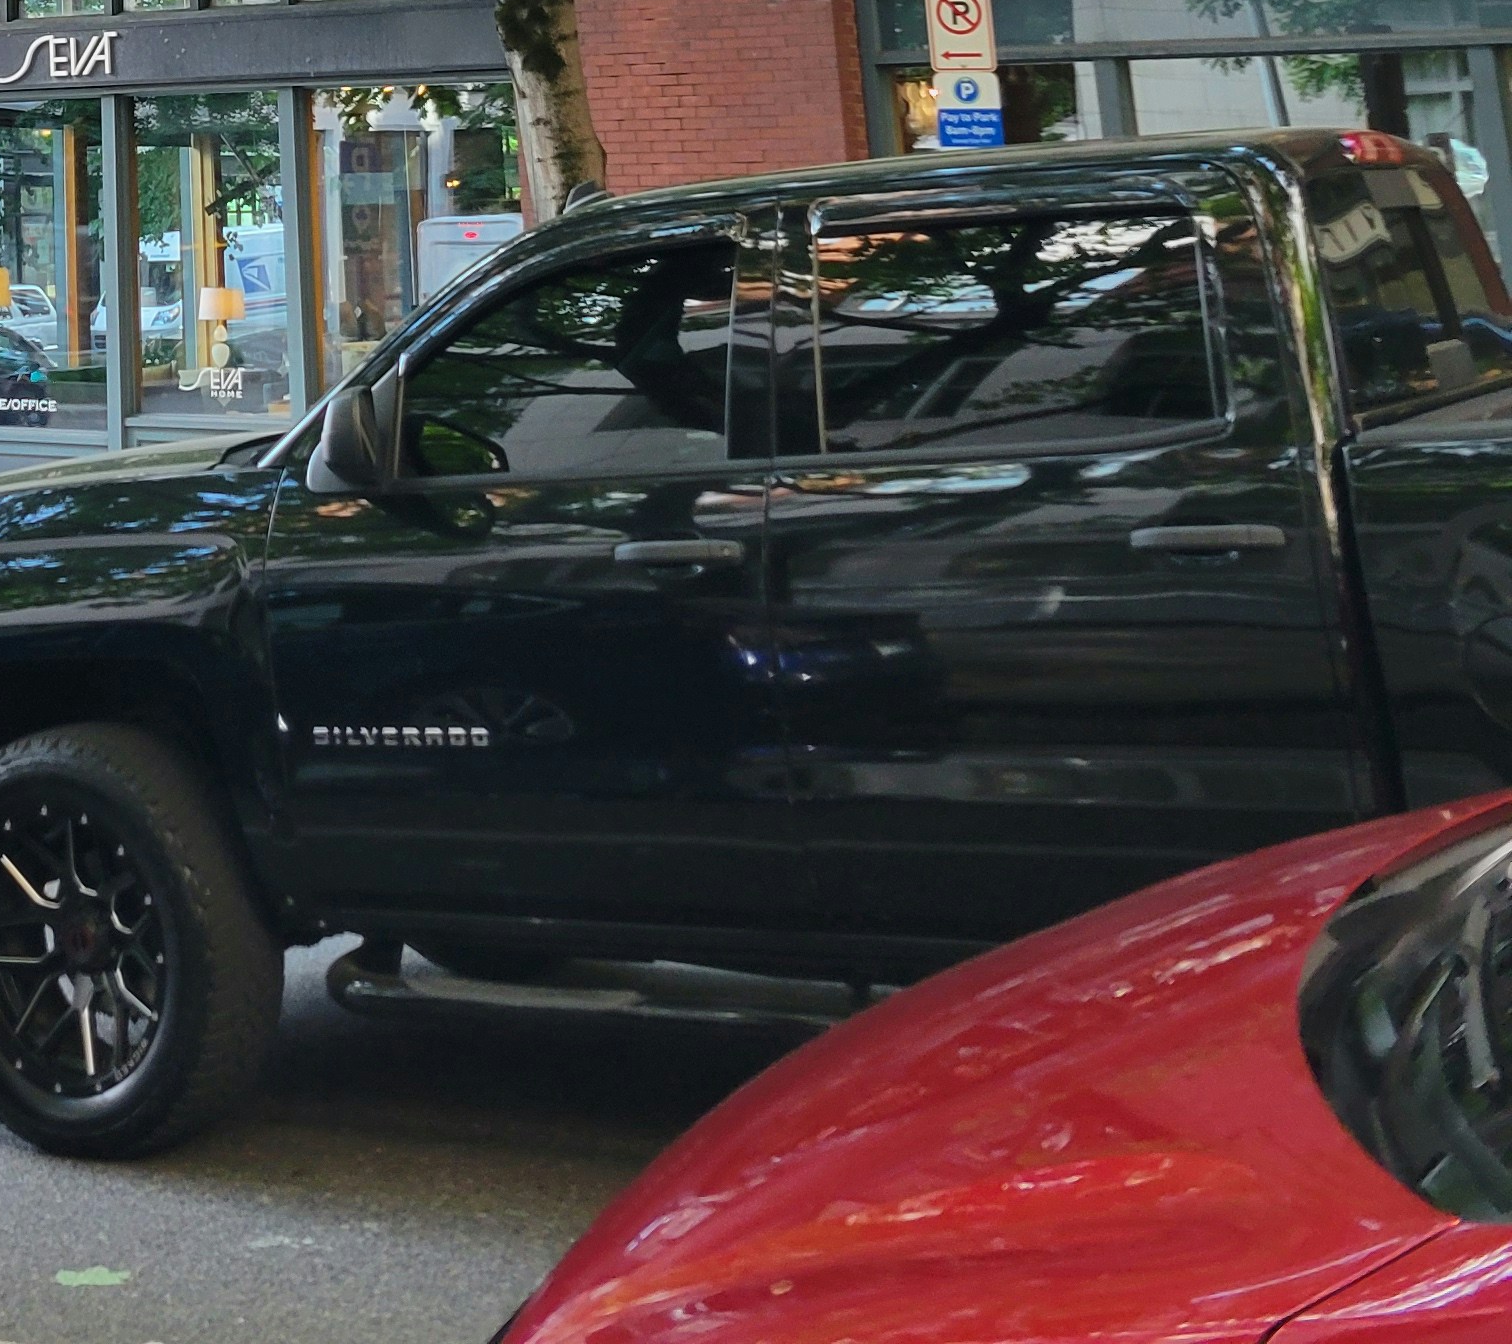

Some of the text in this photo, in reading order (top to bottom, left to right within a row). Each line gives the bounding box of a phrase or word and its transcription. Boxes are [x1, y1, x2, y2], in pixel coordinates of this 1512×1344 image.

[960, 82, 975, 99] P
[178, 366, 245, 391] SEVA
[210, 390, 243, 399] HOME
[313, 726, 490, 747] SILVERADO
